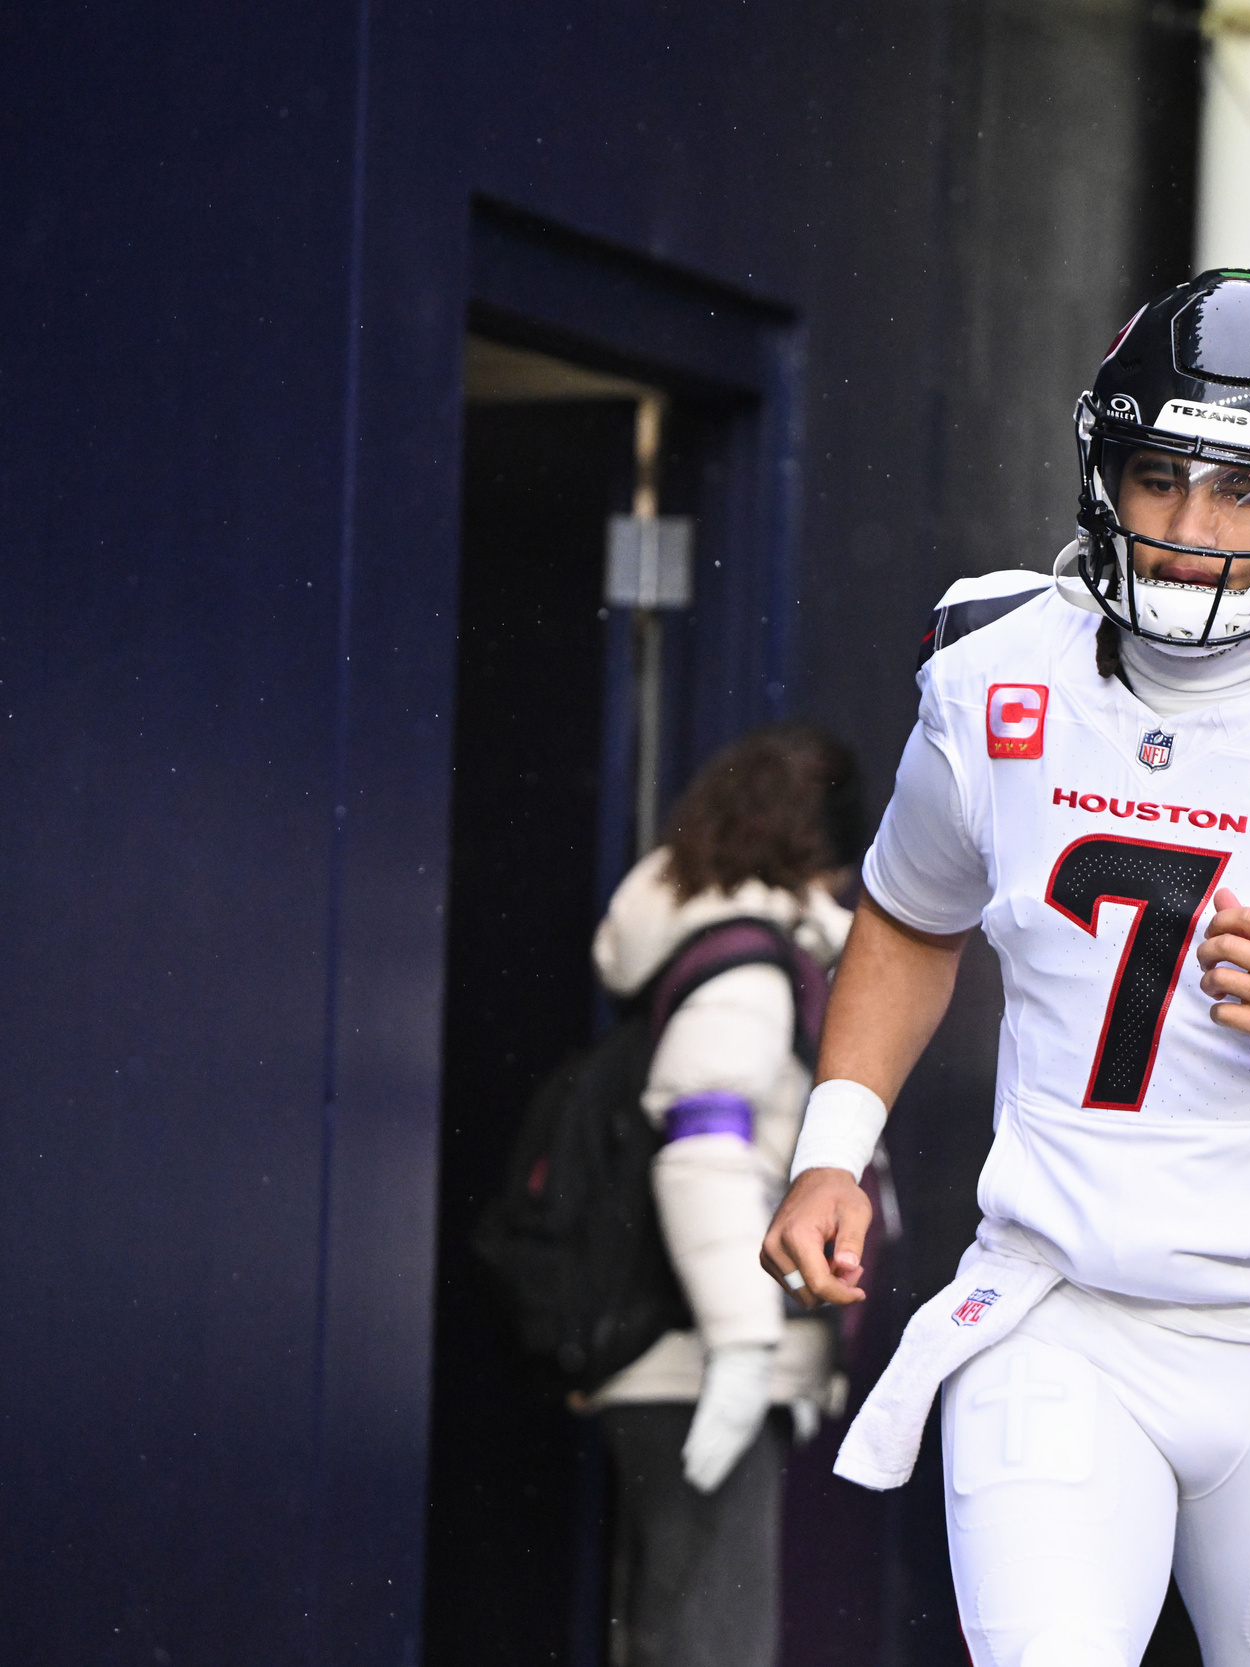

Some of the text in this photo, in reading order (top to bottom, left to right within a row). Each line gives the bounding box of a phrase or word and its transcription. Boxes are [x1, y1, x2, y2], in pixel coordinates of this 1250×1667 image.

[1106, 409, 1136, 421] OAKLEY
[1170, 404, 1248, 426] TEXANS
[989, 687, 1042, 739] C
[1141, 744, 1167, 765] NFL
[1052, 787, 1249, 834] HOUSTON
[1044, 833, 1233, 1112] 7
[955, 1300, 986, 1323] NFL
